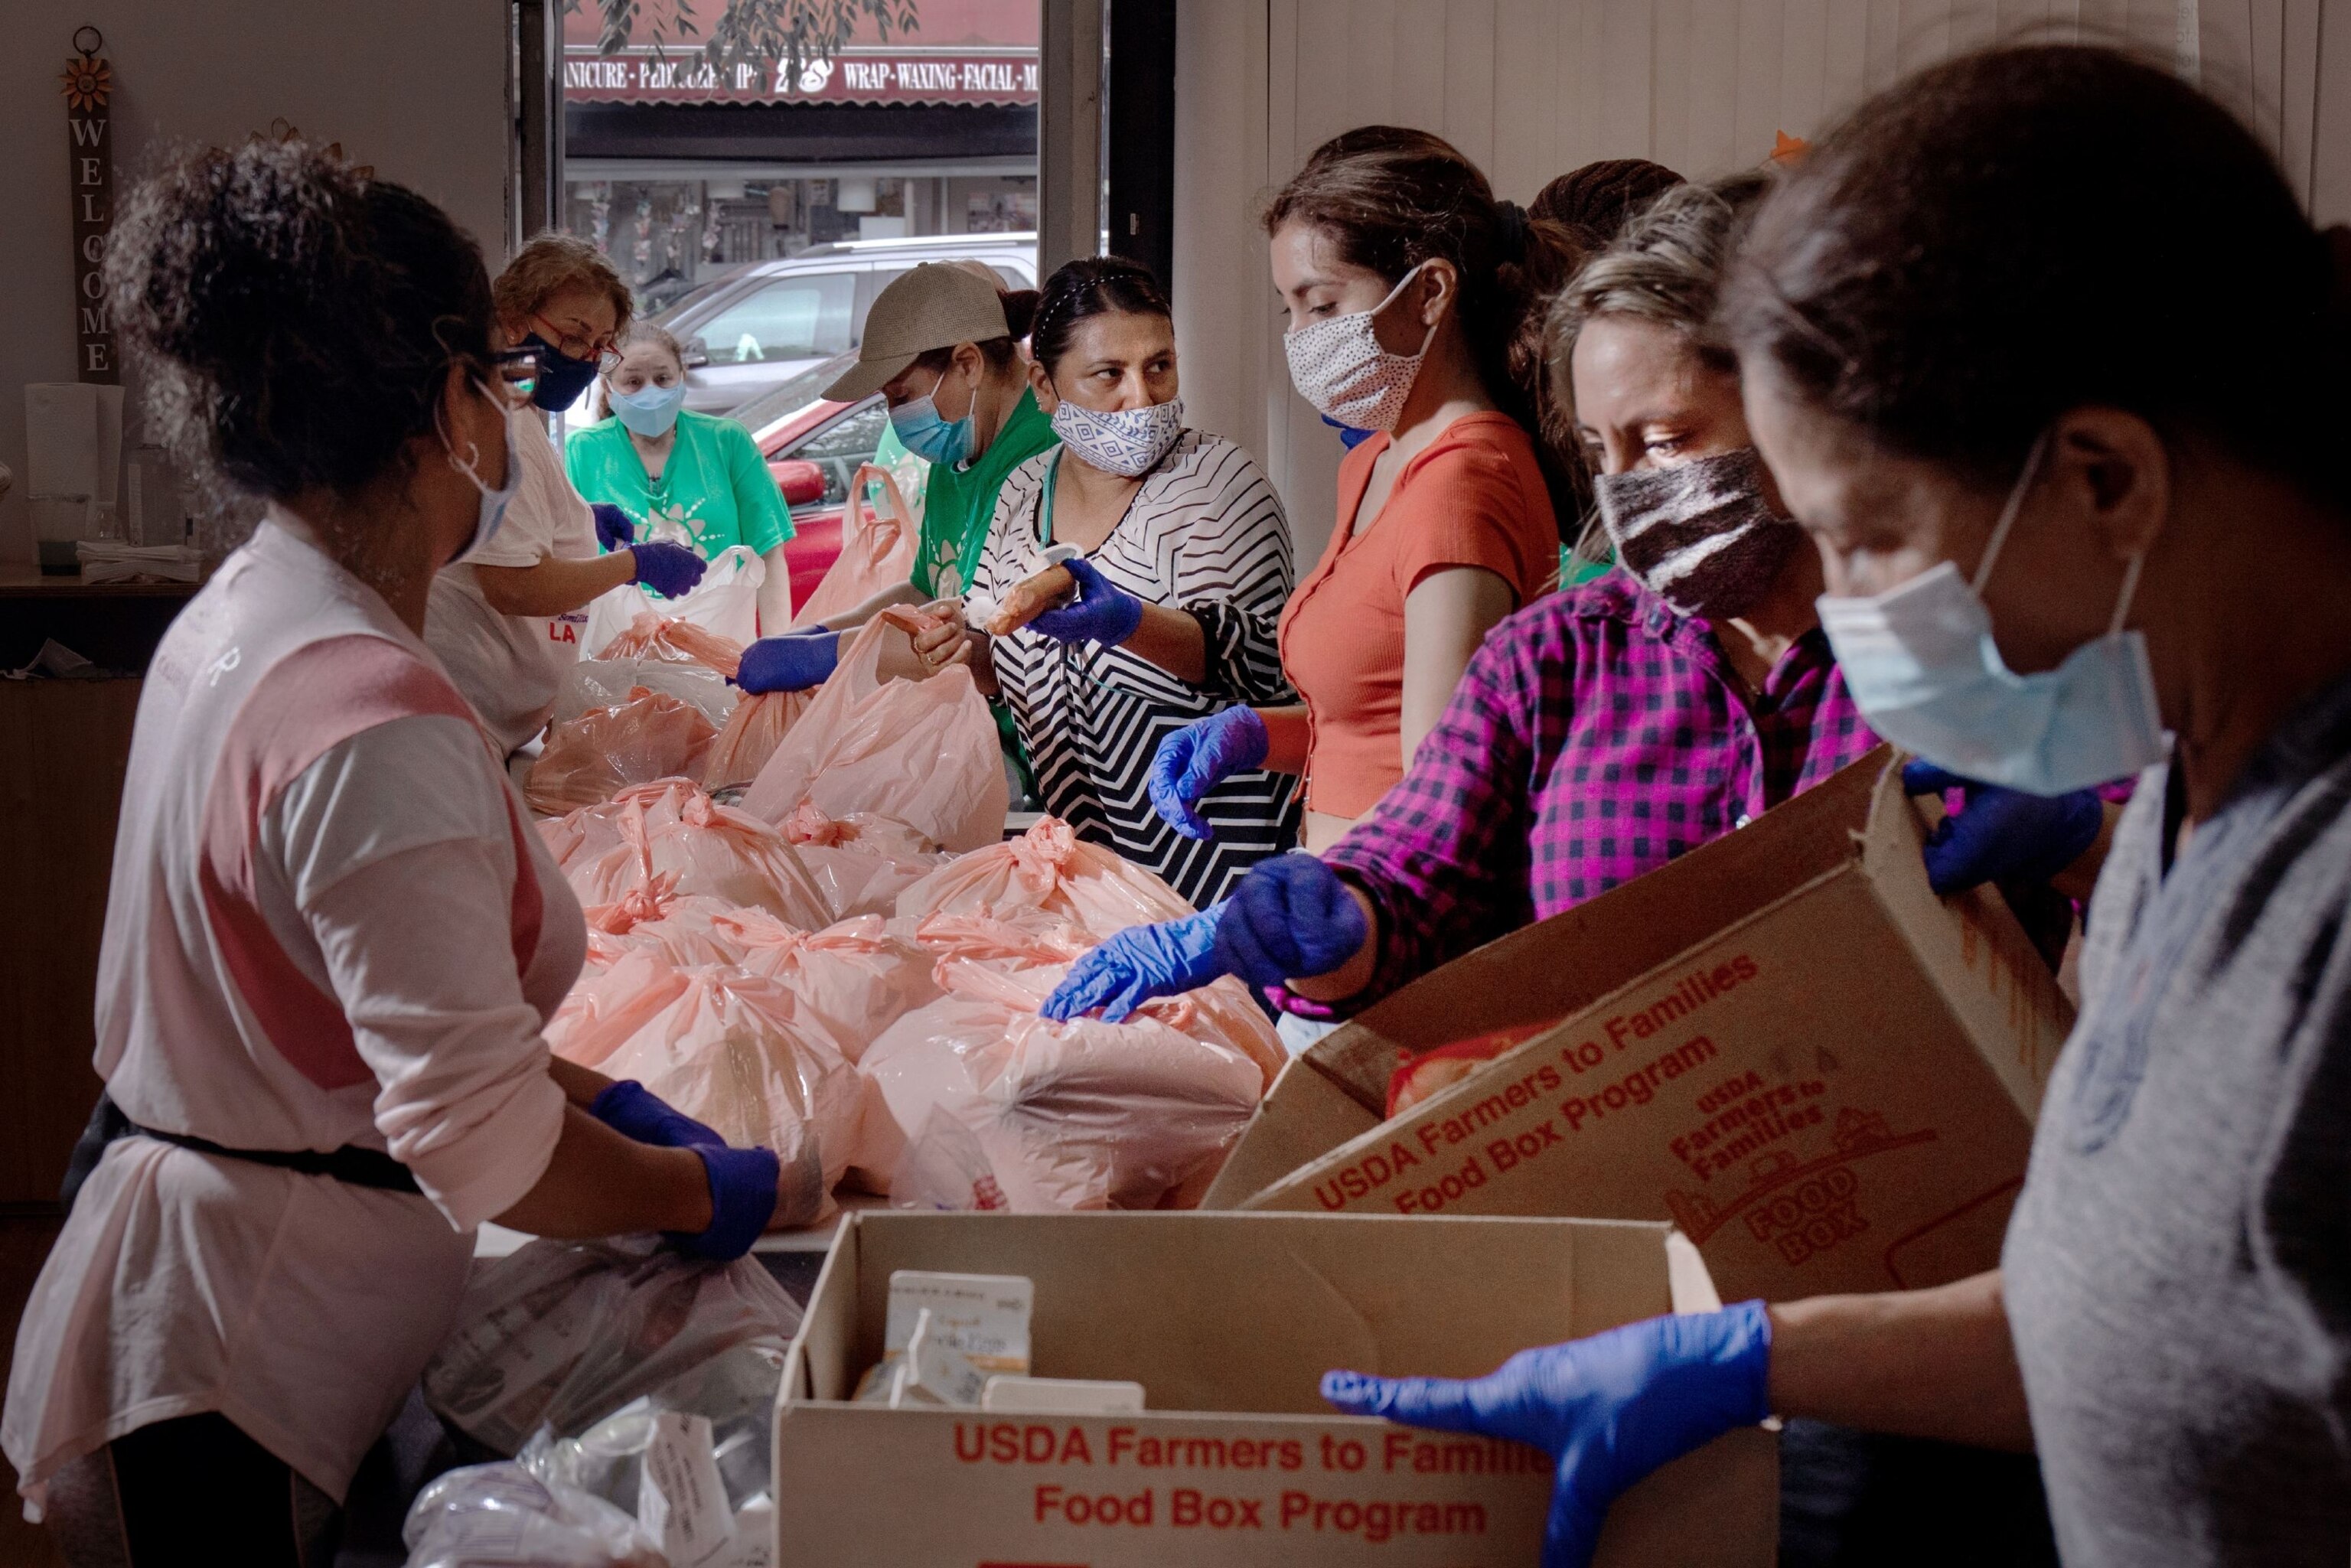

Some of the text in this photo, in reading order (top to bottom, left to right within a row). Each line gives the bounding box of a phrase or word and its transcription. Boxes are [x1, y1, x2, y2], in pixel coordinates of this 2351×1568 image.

[843, 63, 890, 90] WRAP
[895, 63, 956, 90] WAXING
[963, 63, 1016, 91] FACIAL
[70, 119, 109, 372] WELCOME
[549, 621, 576, 644] LA
[1315, 954, 1758, 1211] USDA Farmers to Families
[1696, 1071, 1764, 1114] USDA
[1394, 1035, 1717, 1214] Food Box Program
[1669, 1085, 1796, 1162] Farmers
[1691, 1104, 1824, 1182] Families
[1743, 1165, 1860, 1243] FOOD
[1776, 1201, 1871, 1266] BOX
[954, 1423, 1554, 1475] USDA Farmers to Familie
[1035, 1483, 1488, 1544] Food Box Program
